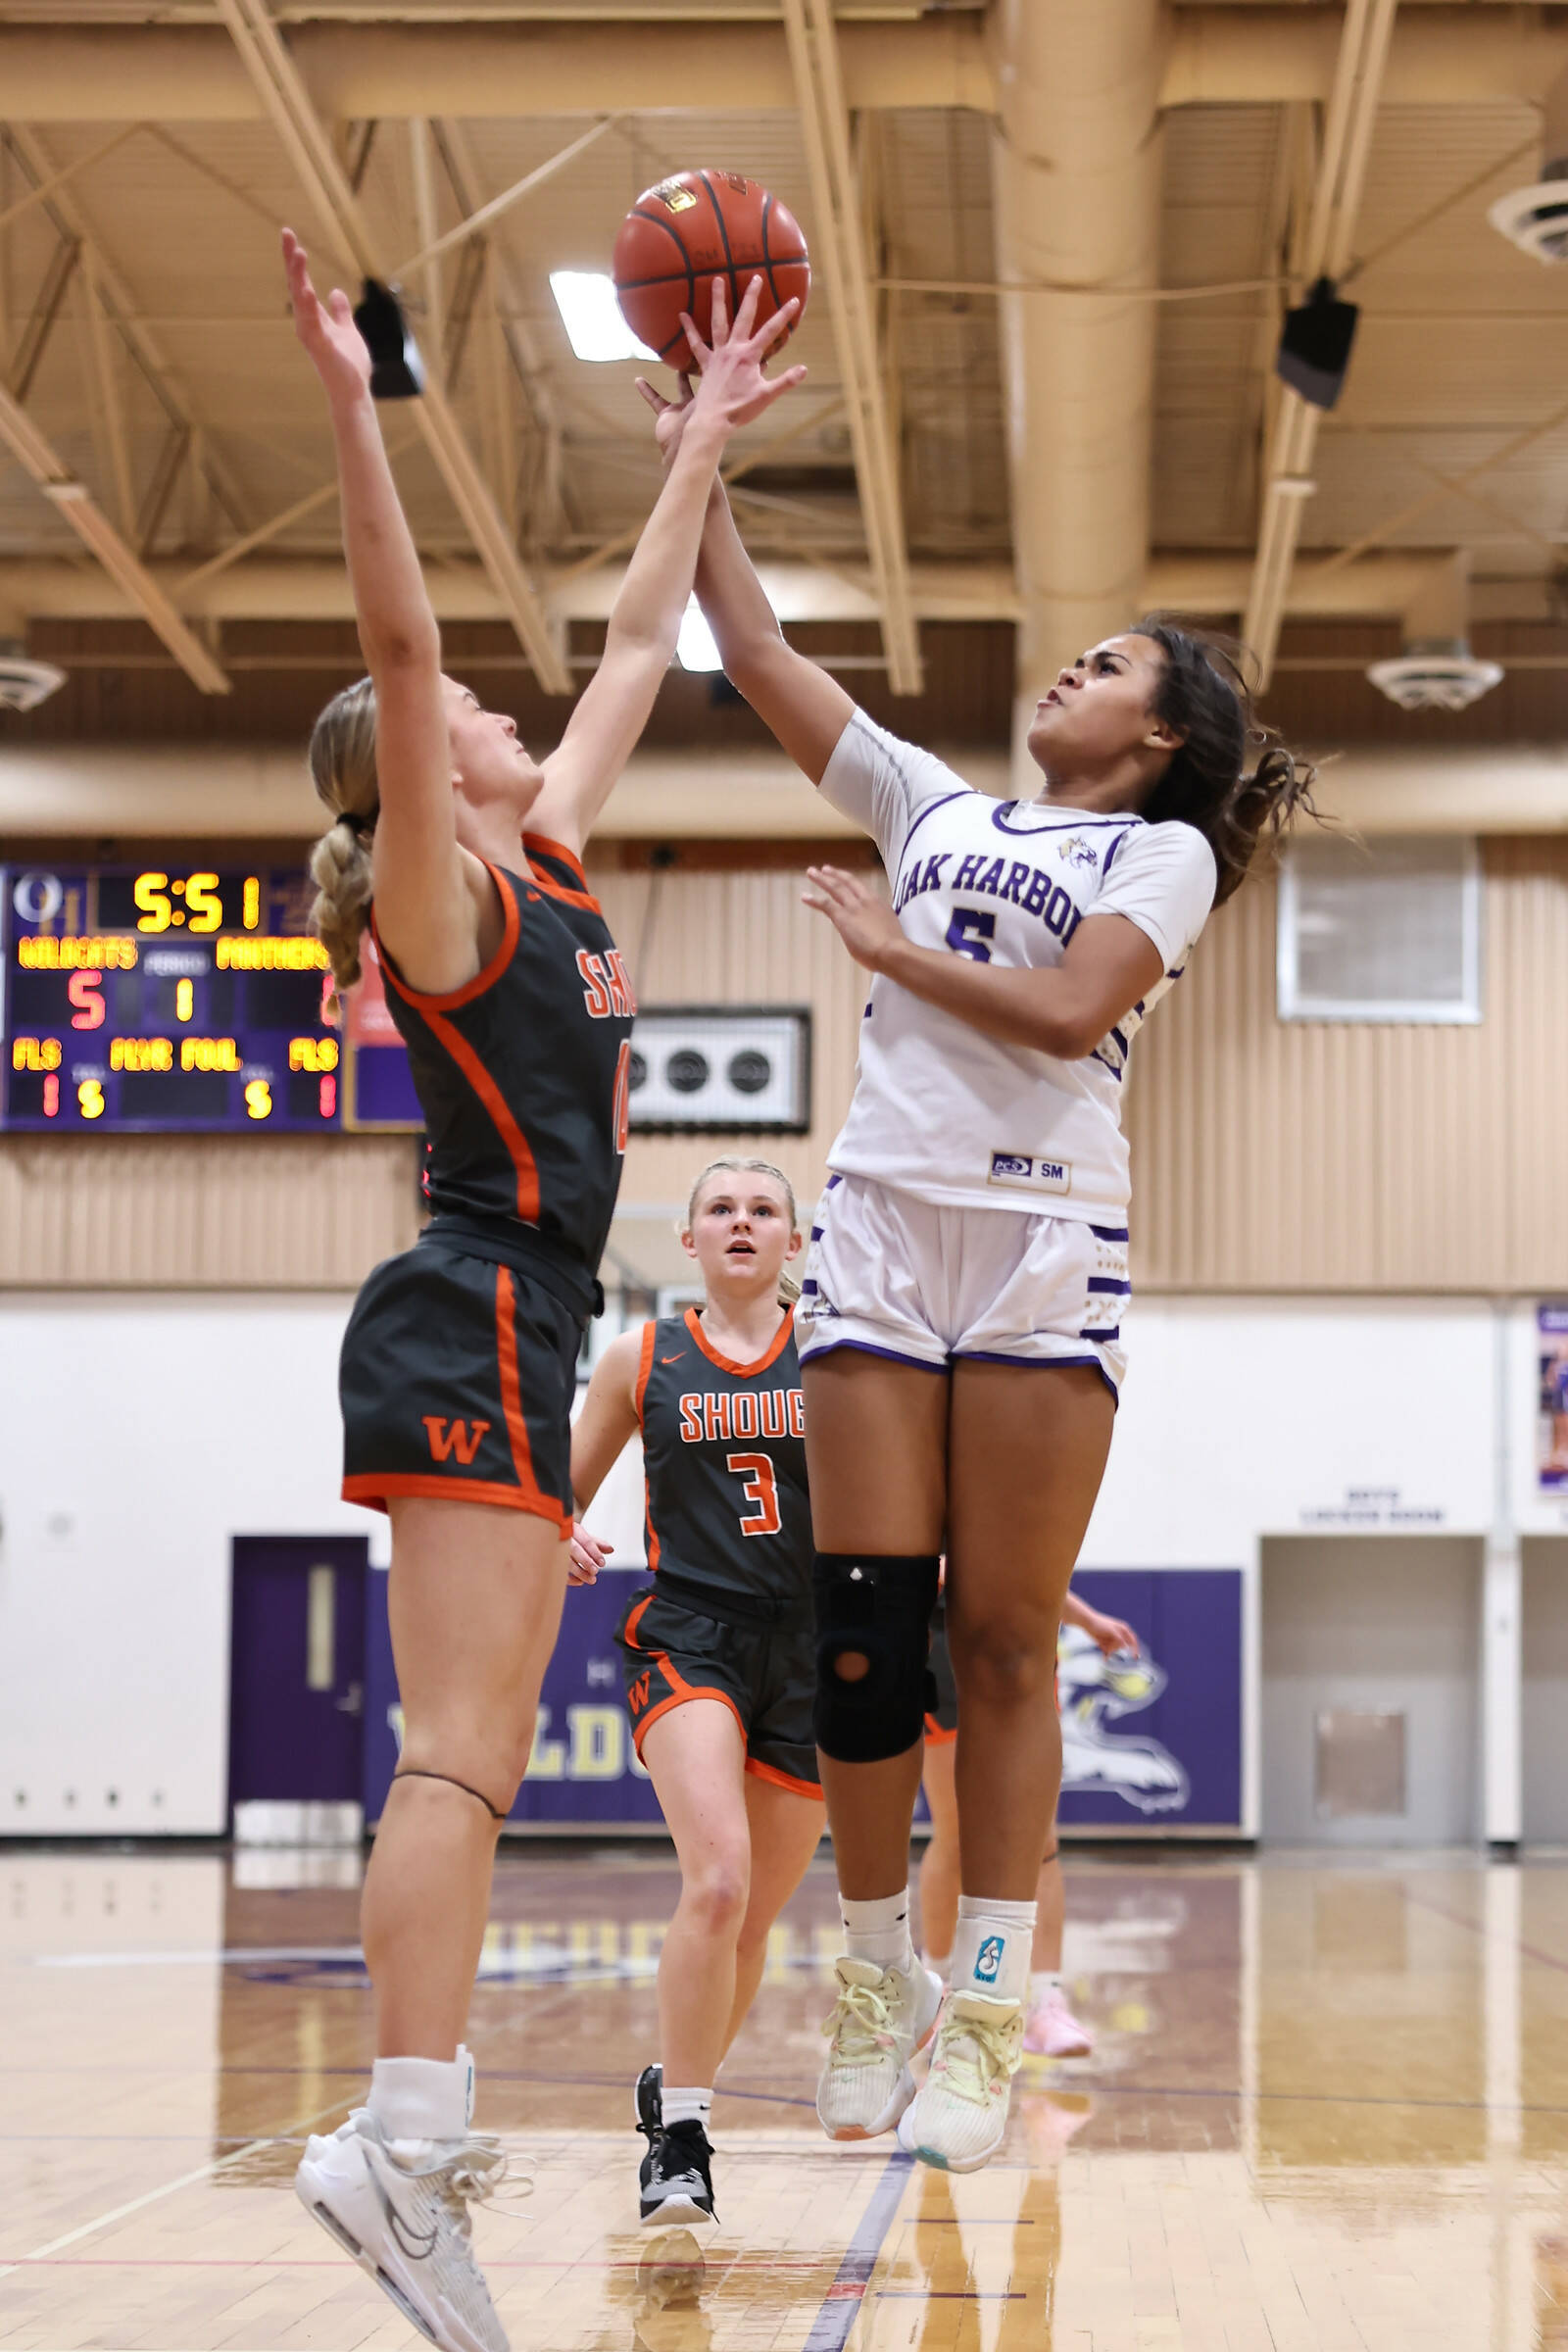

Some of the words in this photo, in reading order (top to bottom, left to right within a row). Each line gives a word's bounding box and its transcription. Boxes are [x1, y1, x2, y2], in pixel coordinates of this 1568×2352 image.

[944, 906, 999, 964] 5
[68, 969, 106, 1030] 5
[175, 978, 194, 1022] 1
[43, 1073, 60, 1117] 1
[318, 1074, 336, 1118] 1
[1041, 1162, 1063, 1180] SM
[421, 1415, 491, 1465] W
[725, 1451, 783, 1538] 3
[627, 1670, 651, 1716] W
